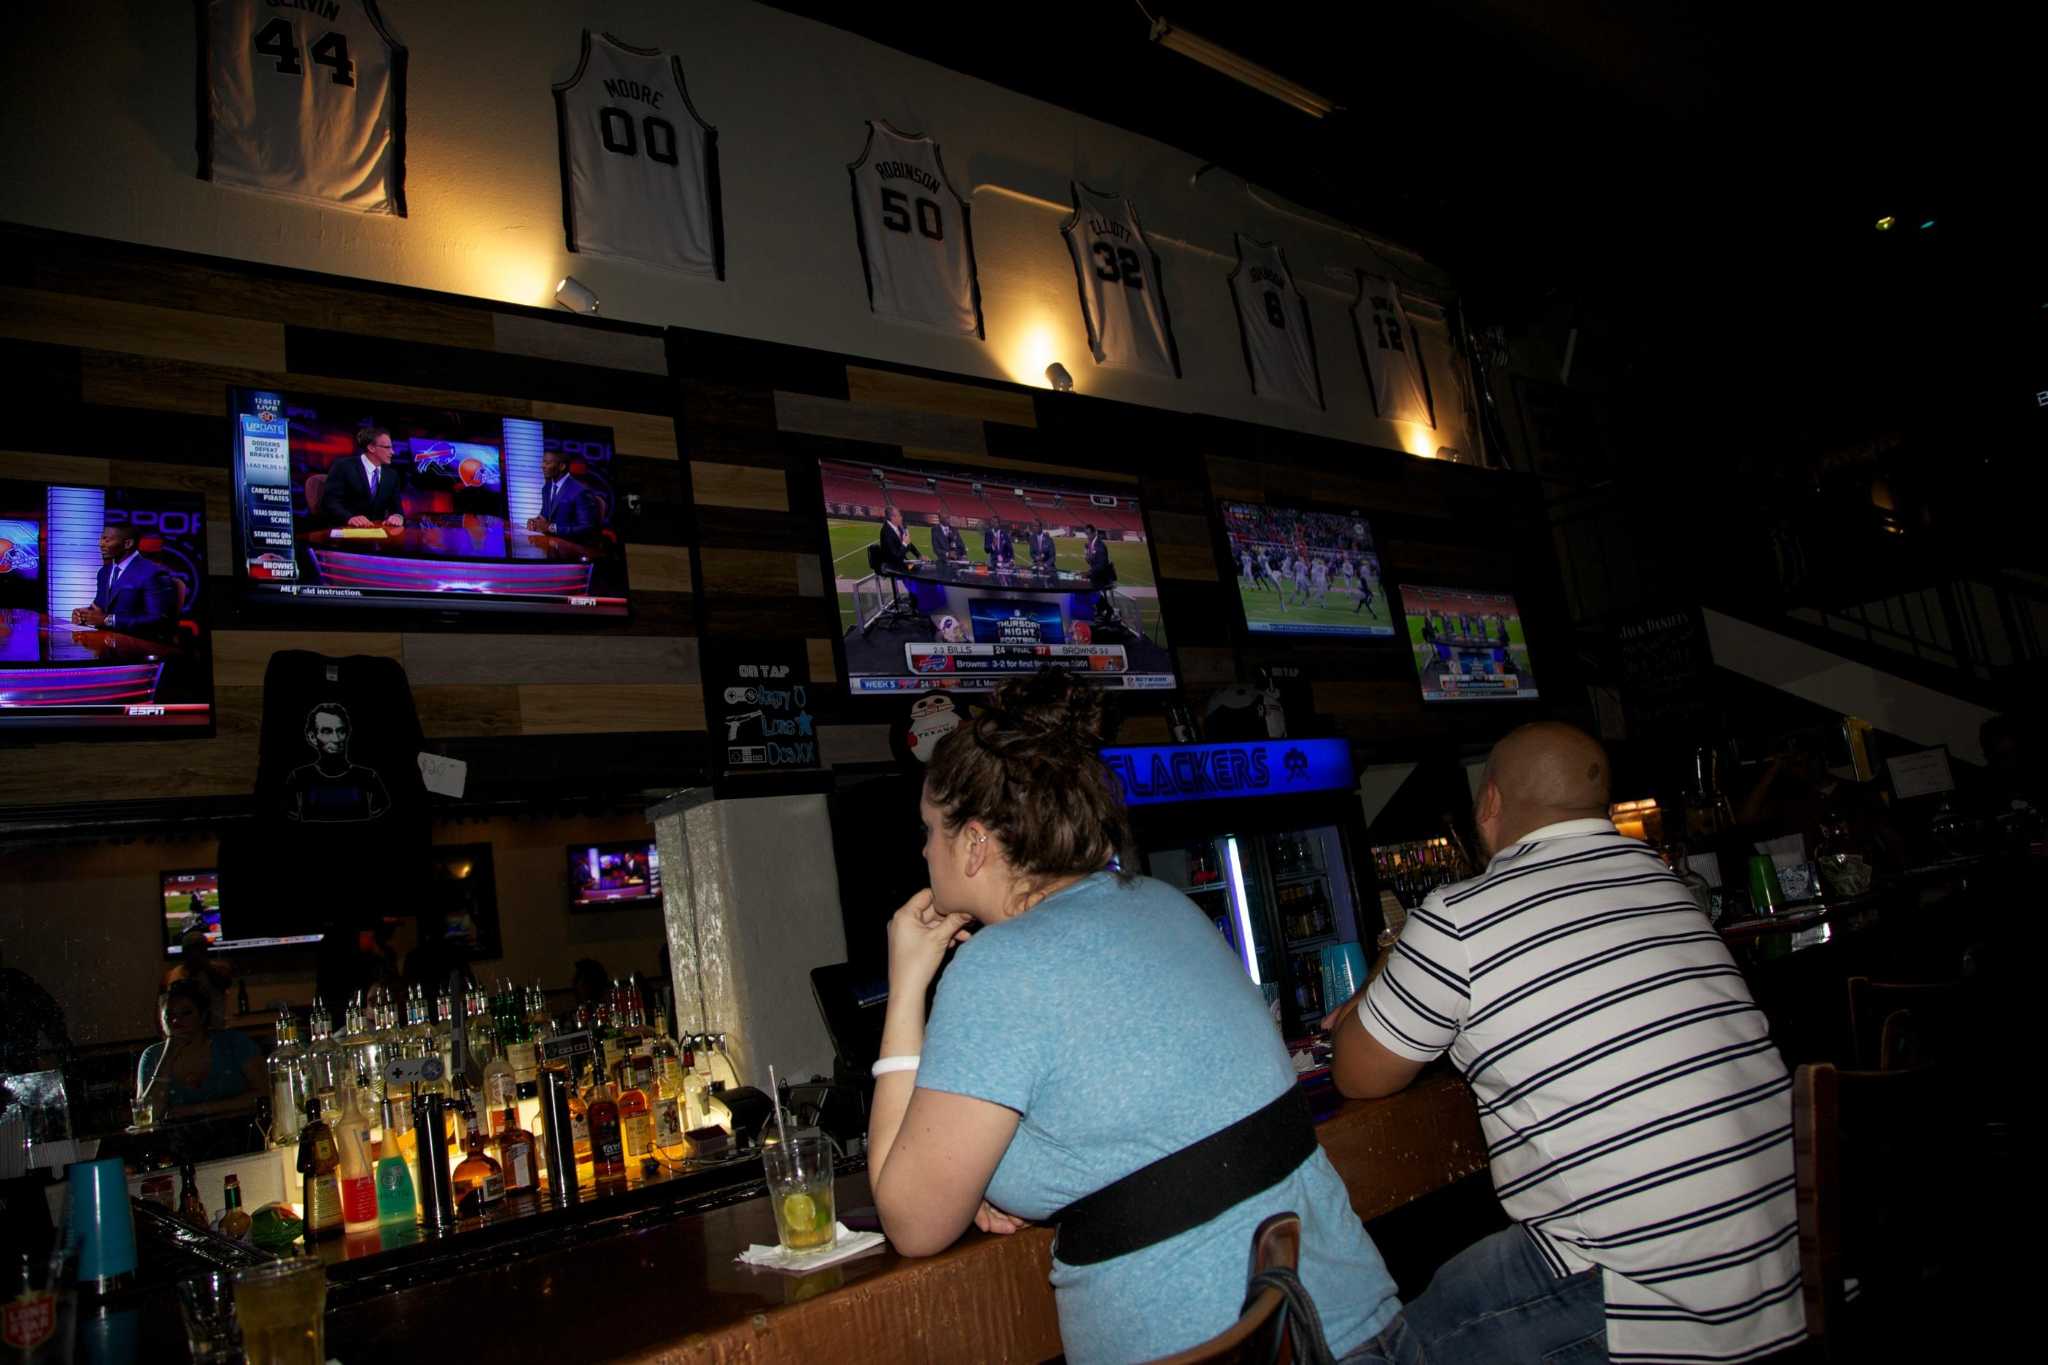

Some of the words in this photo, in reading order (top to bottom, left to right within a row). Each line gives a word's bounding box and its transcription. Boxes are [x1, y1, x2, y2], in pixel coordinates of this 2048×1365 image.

[253, 16, 355, 88] 44
[602, 78, 664, 110] MOORE
[599, 106, 679, 166] 00
[874, 160, 941, 194] ROBINSON
[880, 186, 943, 242] 50
[1092, 242, 1142, 288] 32
[1263, 290, 1284, 329] 6
[1373, 314, 1405, 353] 12
[263, 494, 290, 502] PIRATES
[253, 530, 281, 539] STARTING
[263, 561, 294, 570] BROWNS
[271, 569, 294, 577] ERUPT
[996, 620, 1041, 630] THURSDAY
[1004, 627, 1035, 637] NIGHT
[947, 645, 973, 655] BILLS
[995, 646, 1007, 655] 24
[1062, 646, 1098, 655] BROWNS
[1007, 659, 1018, 669] for
[759, 664, 790, 679] TAP
[864, 679, 891, 688] WEEK
[128, 704, 165, 717] ESPN
